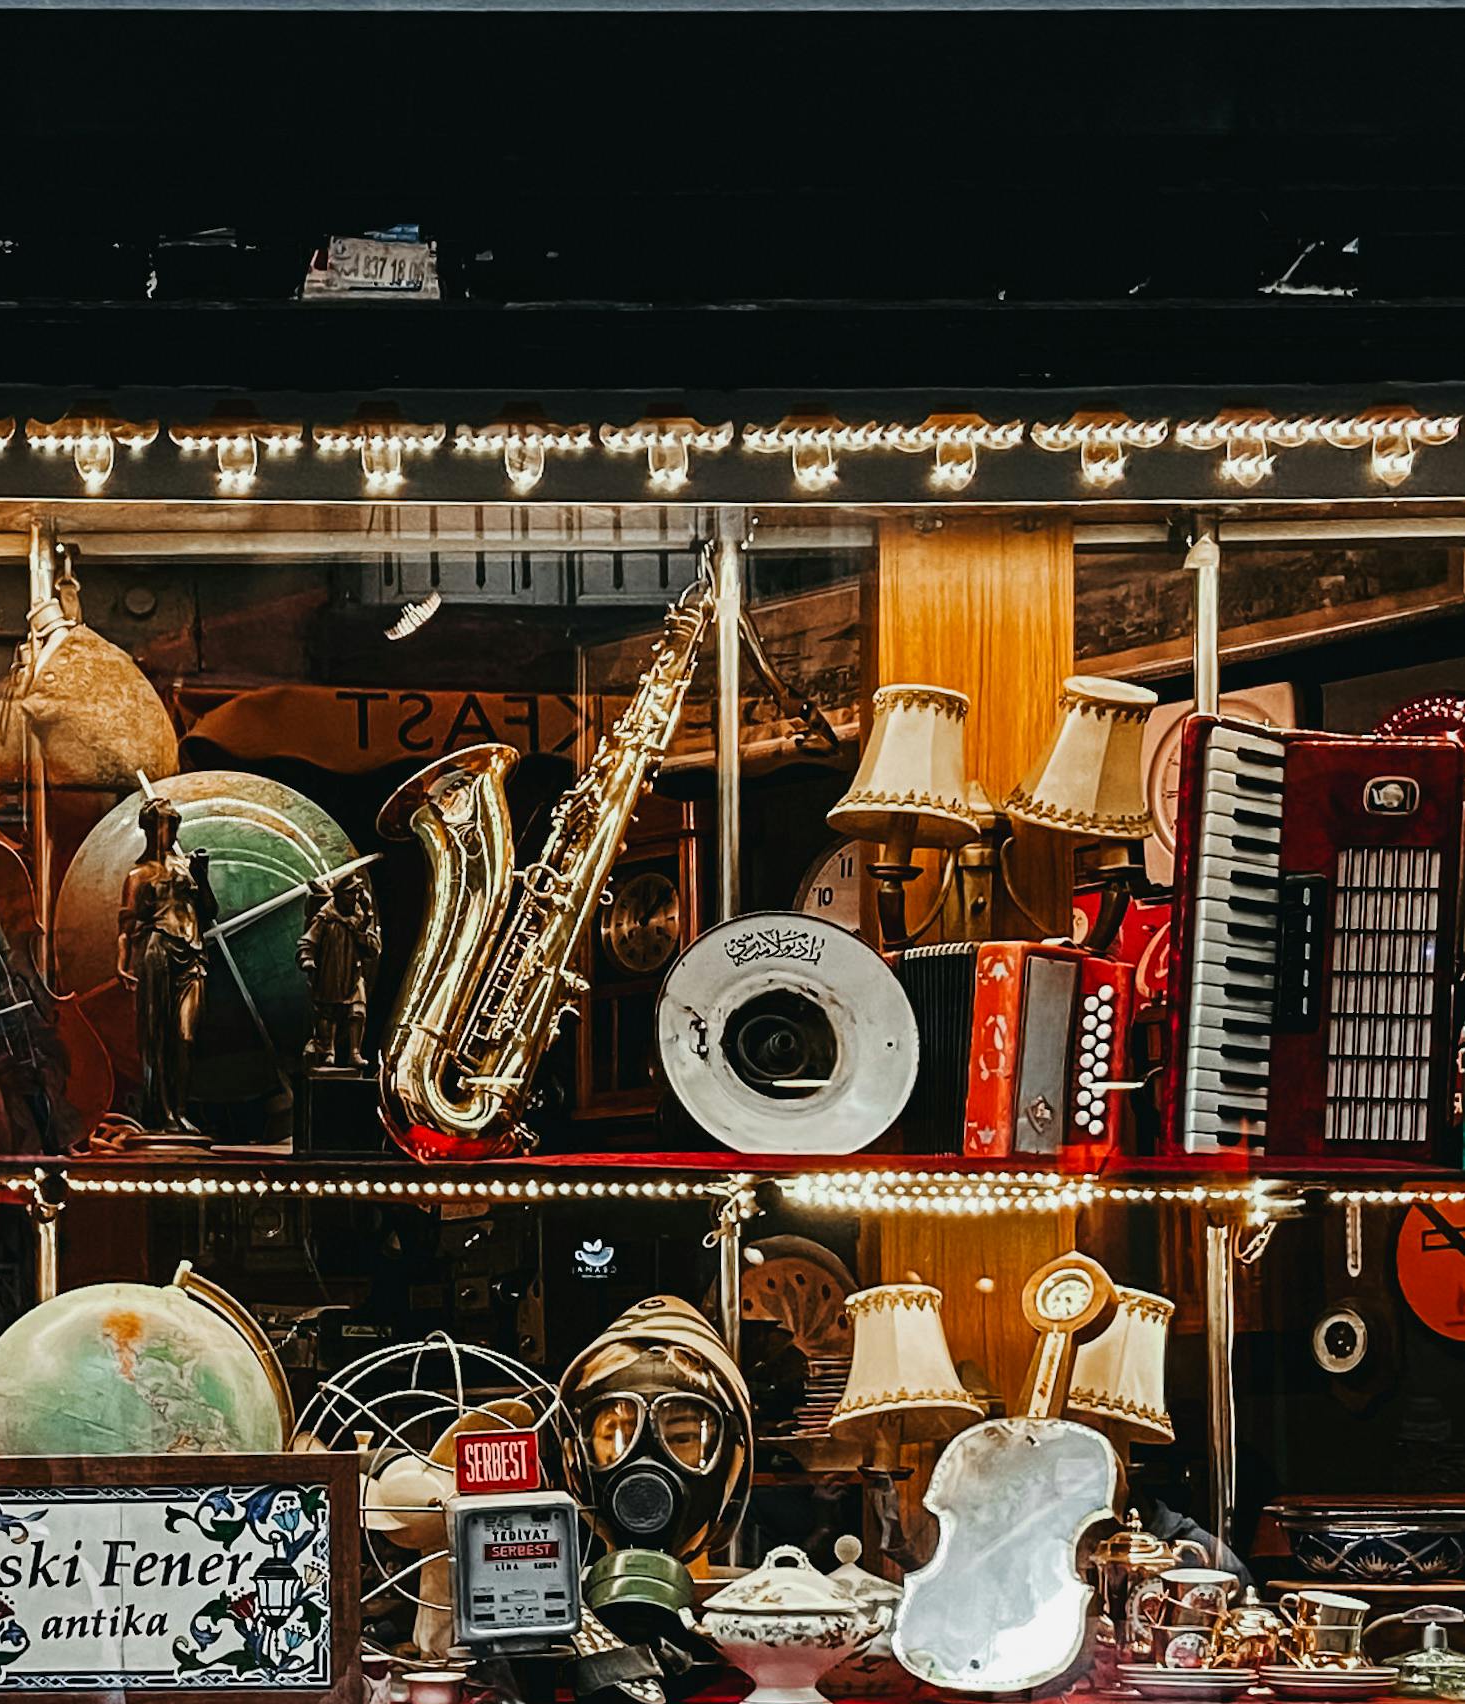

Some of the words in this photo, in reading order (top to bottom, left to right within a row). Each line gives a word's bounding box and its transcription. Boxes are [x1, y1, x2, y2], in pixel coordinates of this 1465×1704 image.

[818, 886, 833, 907] 10
[464, 1440, 528, 1483] SERBEST
[89, 1539, 253, 1588] Fener
[490, 1543, 551, 1558] SERBEST
[41, 1604, 168, 1640] antika
